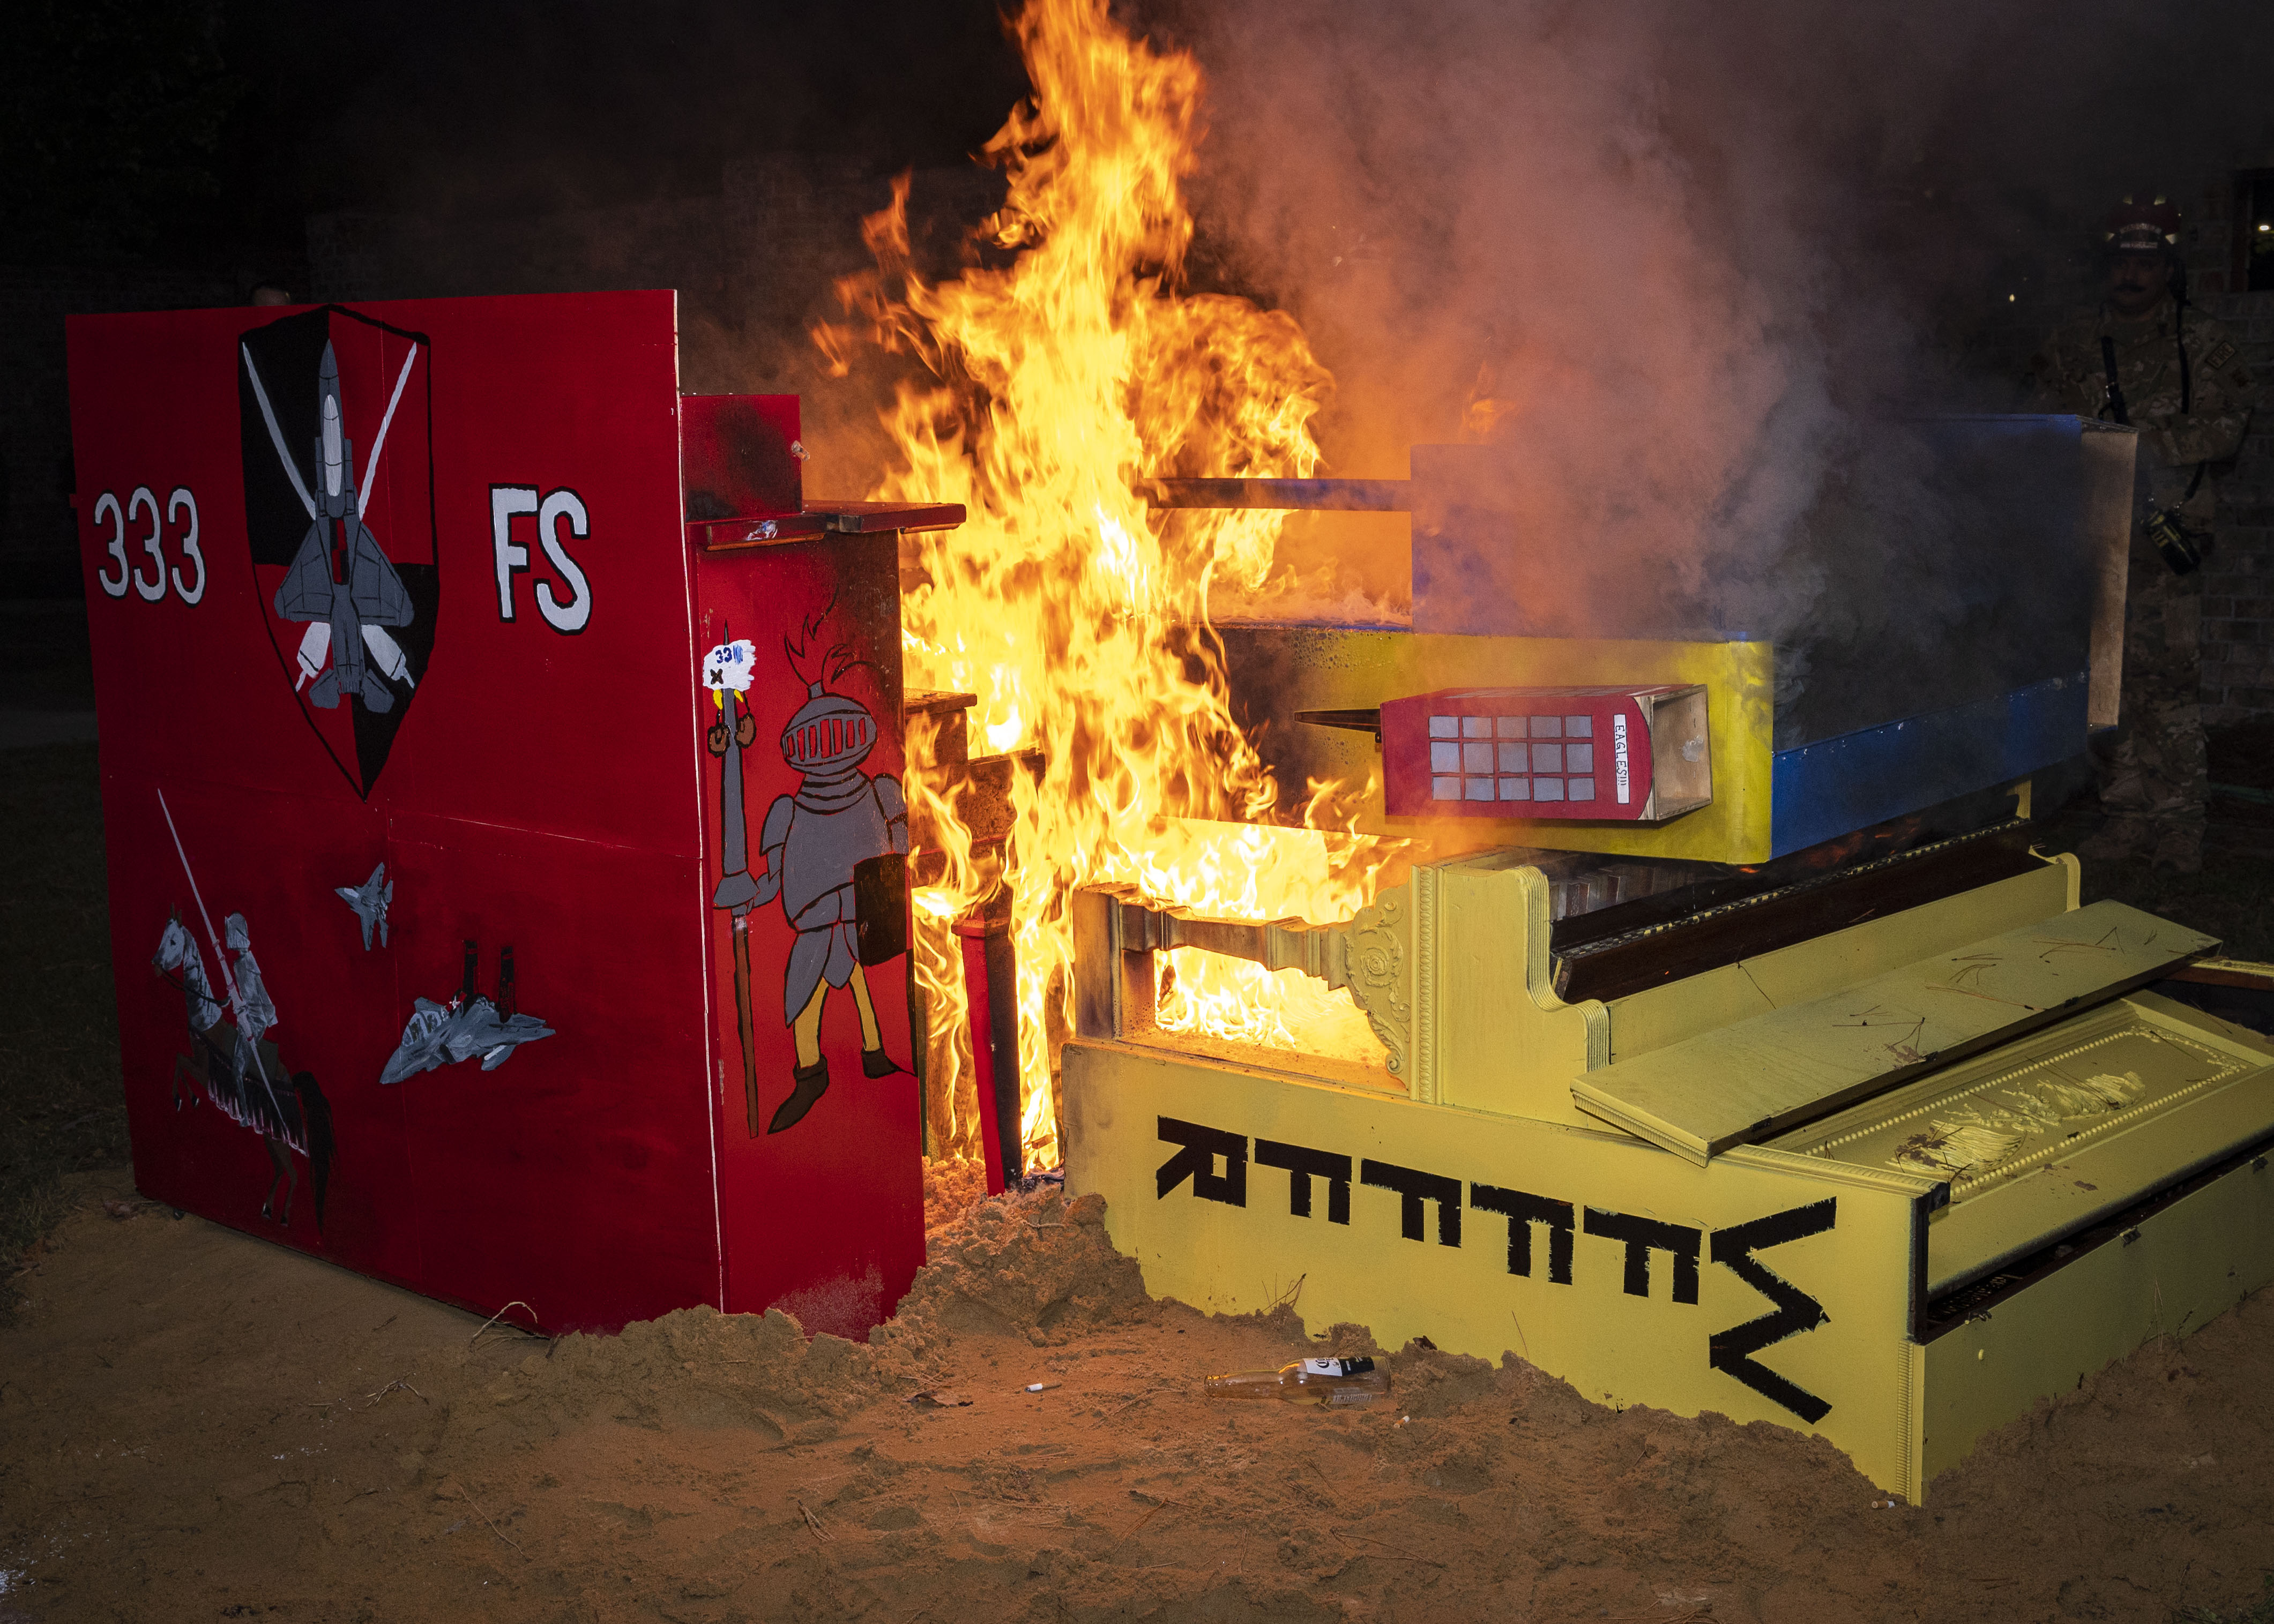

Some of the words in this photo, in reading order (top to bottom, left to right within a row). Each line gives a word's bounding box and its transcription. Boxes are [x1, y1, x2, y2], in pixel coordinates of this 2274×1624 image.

[93, 484, 206, 608] 333
[489, 483, 592, 636] FS
[715, 644, 743, 665] 33
[1615, 725, 1627, 786] EAGLES!!!
